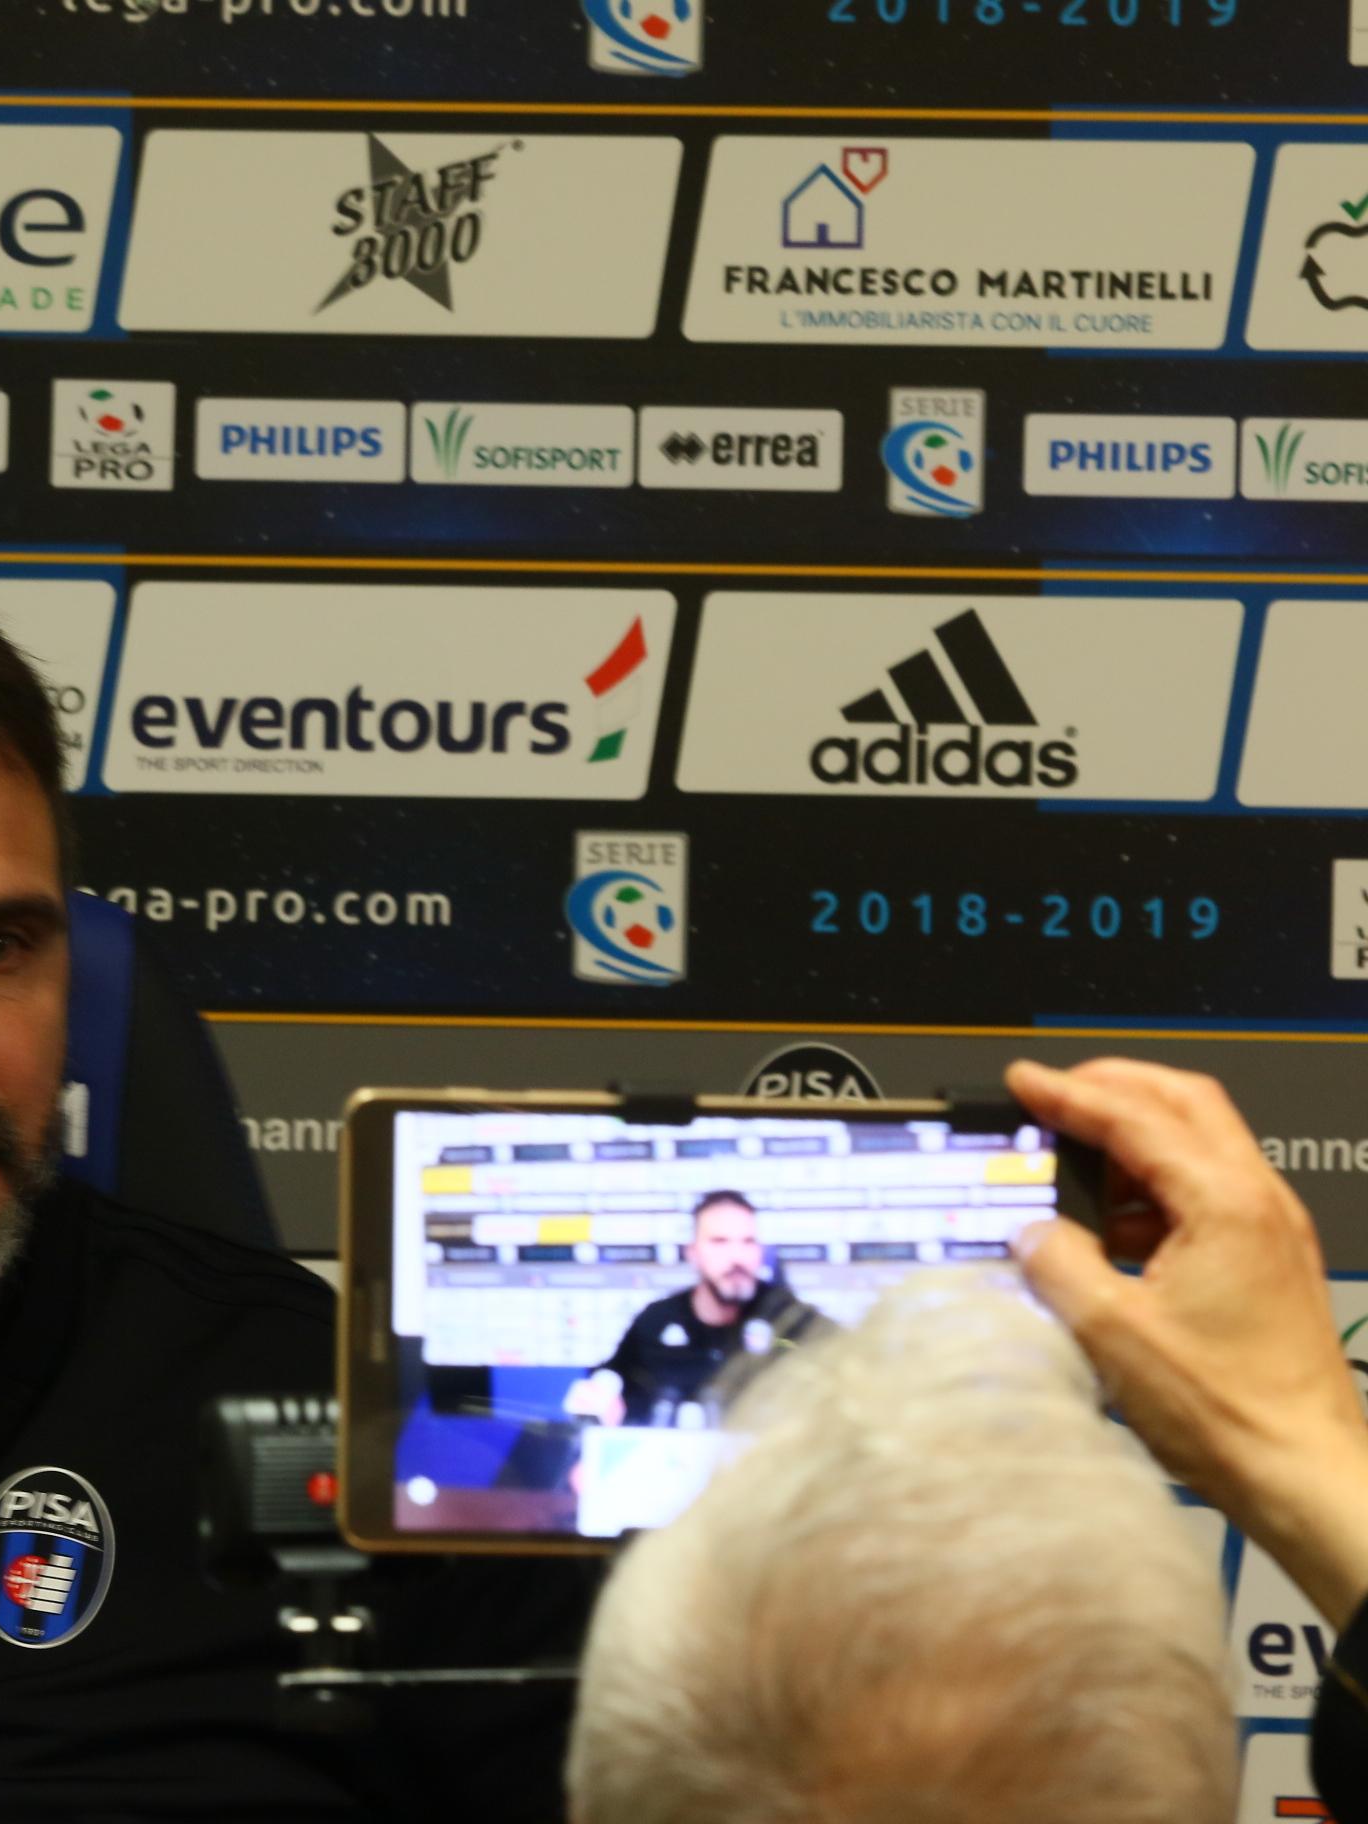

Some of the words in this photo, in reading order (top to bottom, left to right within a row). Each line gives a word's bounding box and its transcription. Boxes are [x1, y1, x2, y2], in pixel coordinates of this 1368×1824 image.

[331, 150, 499, 237] STAFF
[350, 212, 481, 288] 3000
[724, 265, 958, 296] FRANCESCO
[978, 269, 1213, 301] MARTINELLI
[992, 312, 1041, 331] CON
[1047, 314, 1068, 332] IL
[1074, 314, 1153, 333] CUORE
[900, 396, 975, 417] SERIE
[73, 441, 151, 456] LEGA
[220, 424, 382, 457] PHILIPS
[711, 431, 818, 467] errea
[73, 459, 154, 482] PRO
[474, 445, 620, 471] SOFISPORT
[1049, 440, 1212, 473] PHILIPS
[1304, 461, 1368, 486] SOFI
[132, 684, 570, 755] eventours
[136, 756, 165, 771] THE
[173, 757, 228, 772] SPORT
[234, 758, 324, 774] DIRECTION
[810, 722, 1079, 788] adidas
[586, 842, 677, 866] SERIE
[811, 890, 1220, 939] 2018-2019
[756, 1070, 868, 1101] PISA
[1253, 1684, 1284, 1699] THE
